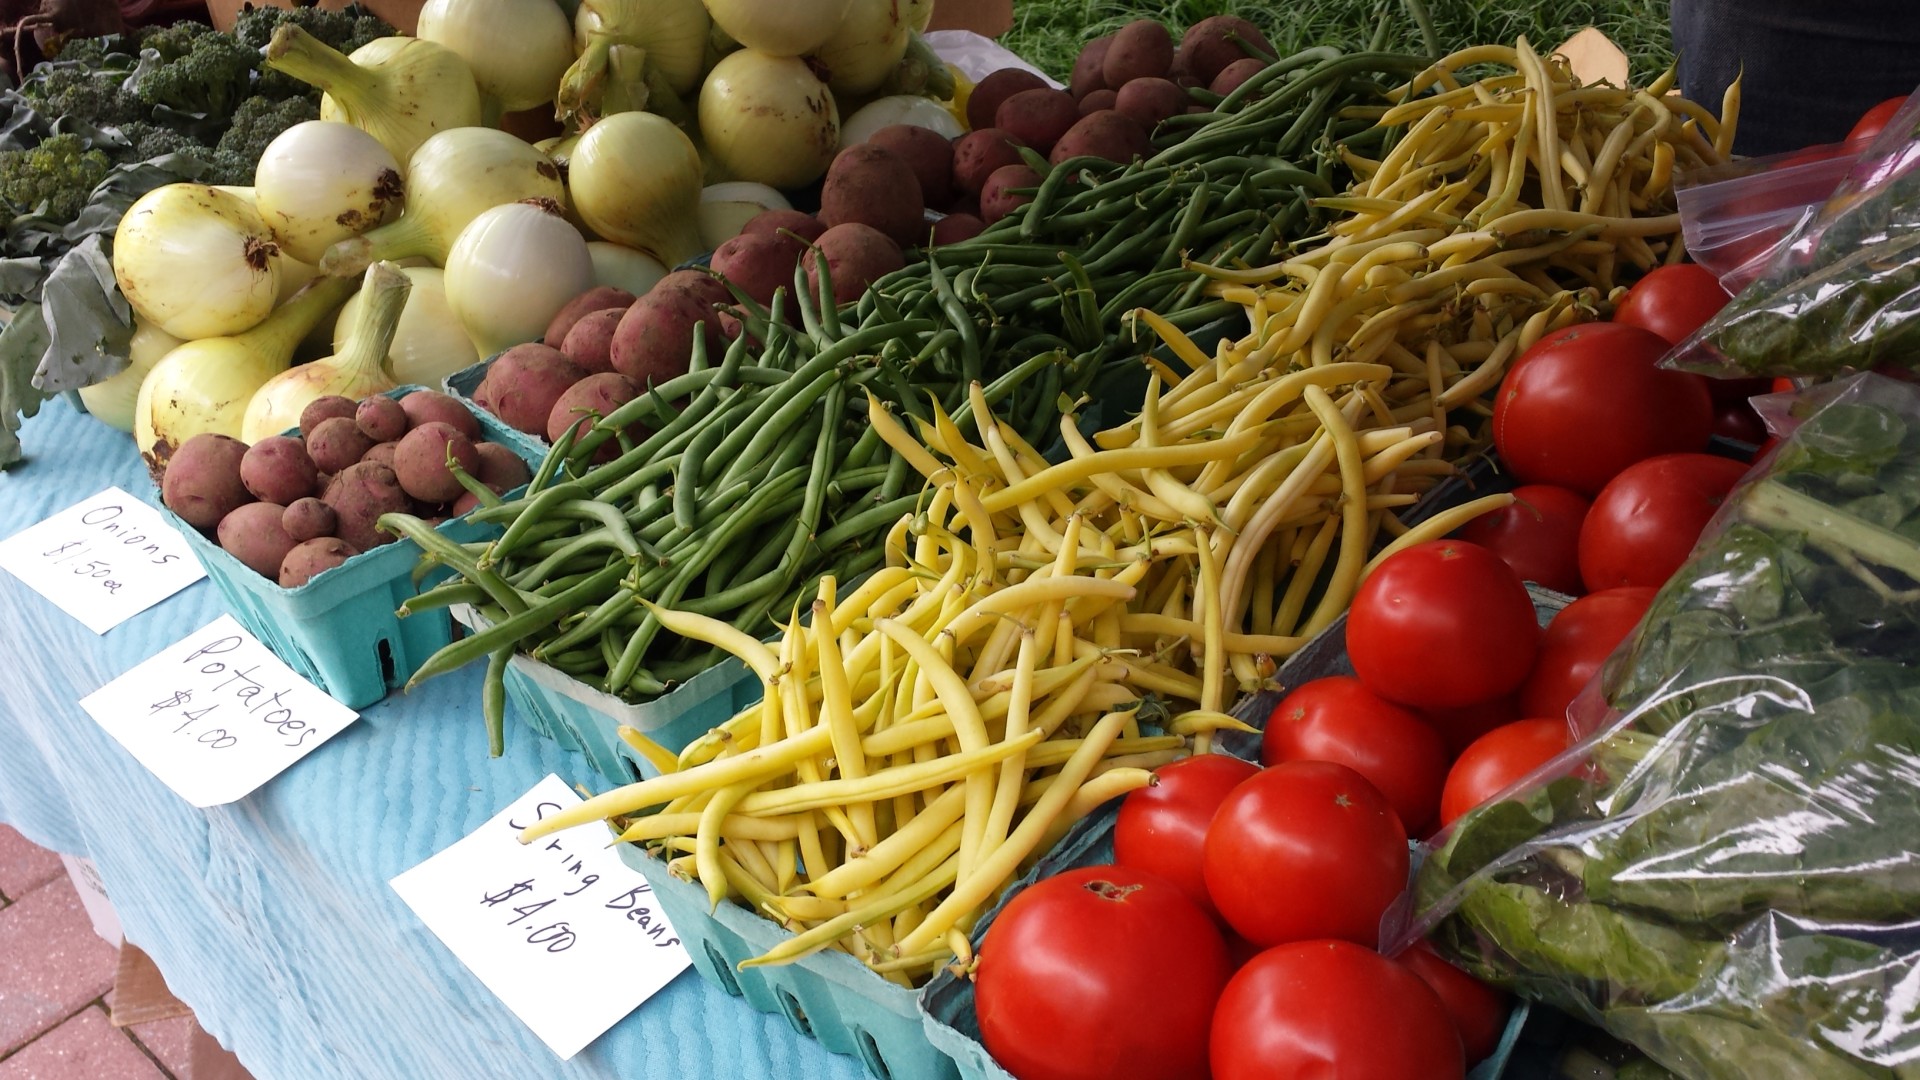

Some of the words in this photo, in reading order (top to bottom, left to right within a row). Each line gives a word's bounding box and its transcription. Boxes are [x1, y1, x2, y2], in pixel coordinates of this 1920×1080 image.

[81, 505, 180, 565] Onions
[149, 688, 238, 749] $4.00
[182, 635, 317, 747] Potatoes
[508, 801, 601, 897] Sring
[604, 883, 682, 948] Beans
[479, 878, 577, 953] $4.00
